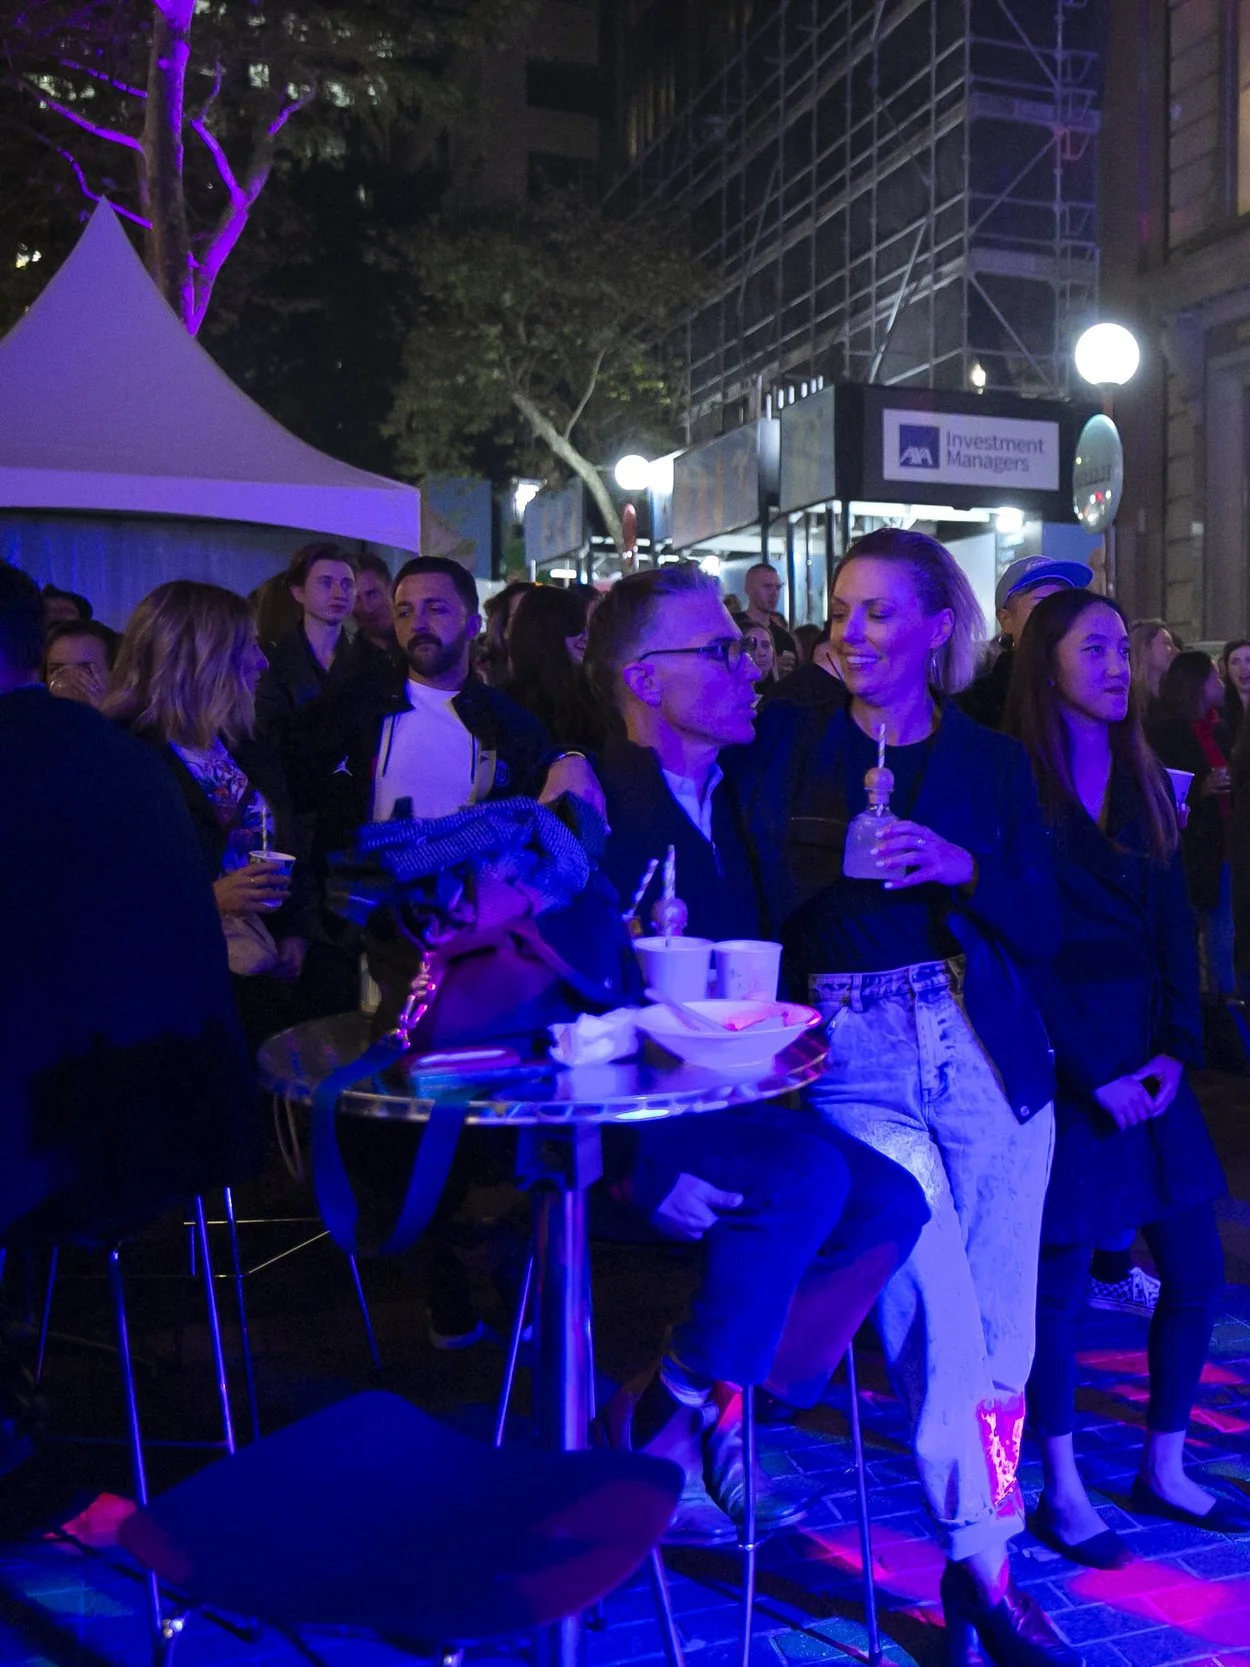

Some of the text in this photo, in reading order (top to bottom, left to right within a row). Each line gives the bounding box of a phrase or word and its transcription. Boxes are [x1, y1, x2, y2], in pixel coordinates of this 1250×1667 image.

[947, 431, 1044, 454] Investment
[900, 446, 933, 466] AXA
[947, 450, 1030, 474] Managers
